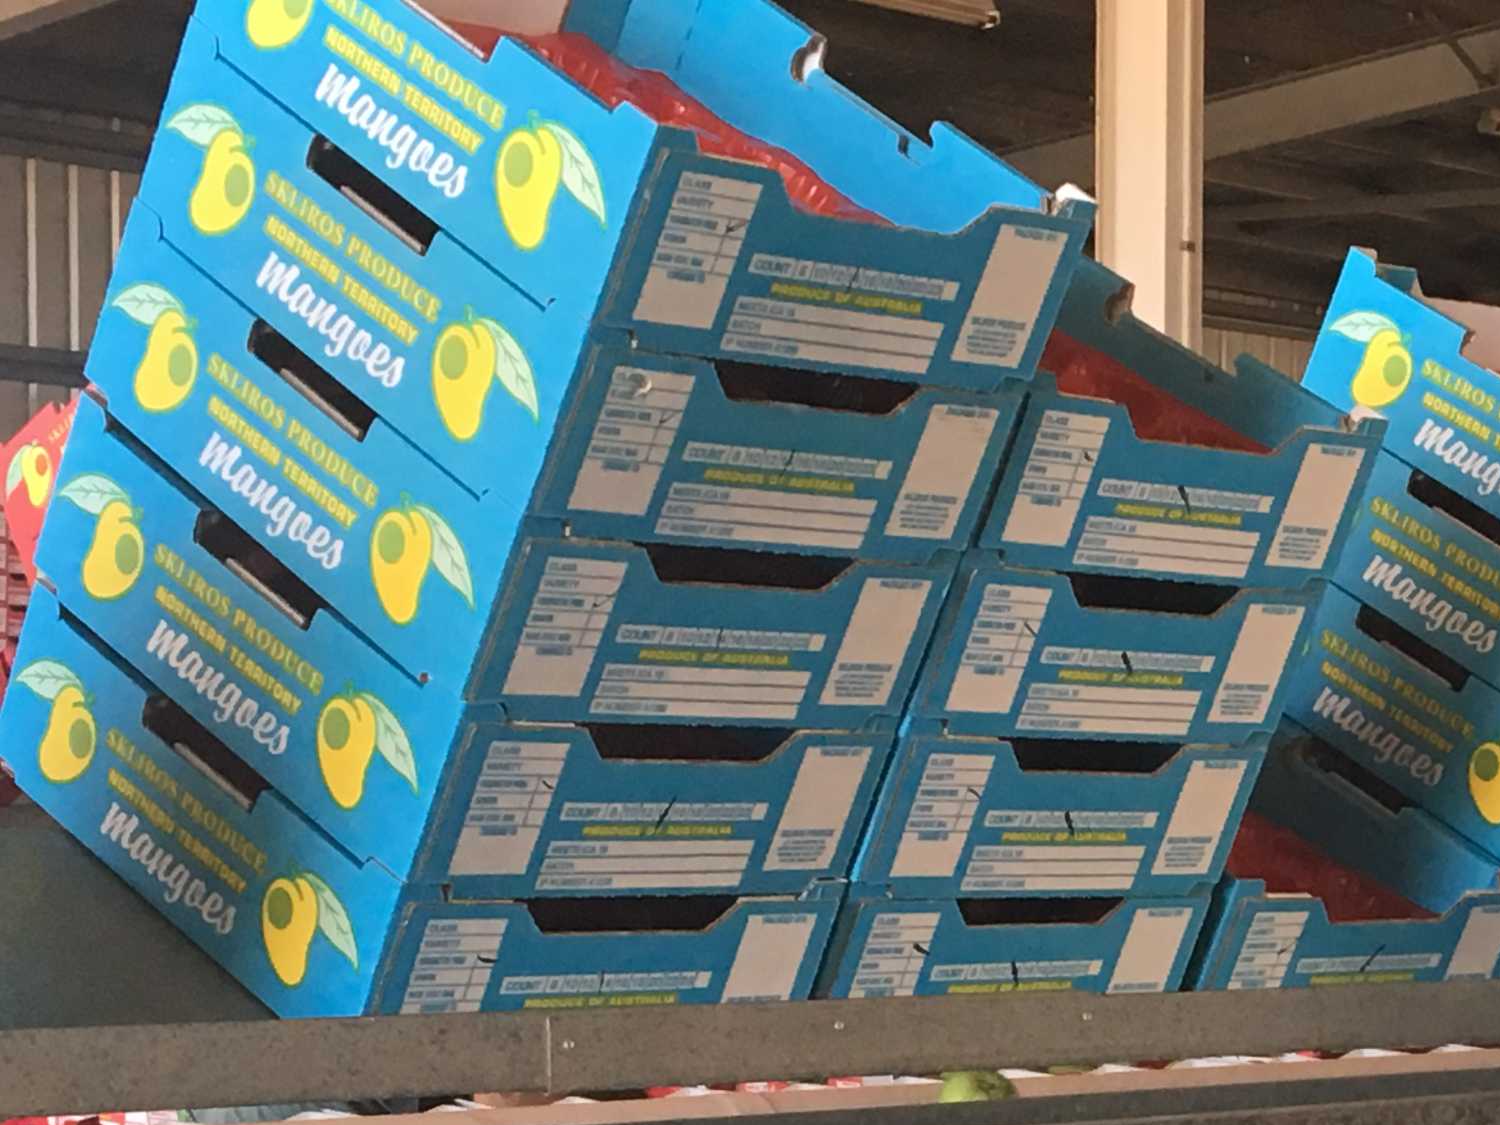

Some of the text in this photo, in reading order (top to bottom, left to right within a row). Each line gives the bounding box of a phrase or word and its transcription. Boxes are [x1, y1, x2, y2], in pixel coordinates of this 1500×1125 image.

[315, 63, 468, 198] Mangoes
[322, 25, 485, 155] NORTHERN TERRITORY
[406, 42, 507, 130] PRODUCE
[263, 214, 420, 348] NORTHERN TERRITORY
[264, 171, 441, 324] SKLIROS PRODUCE
[256, 252, 405, 387] Mangoes
[1422, 358, 1497, 414] SKLIROS
[206, 352, 379, 509] SKLIROS PRODUCE
[207, 394, 358, 530] NORTHERN TERRITORY
[1422, 392, 1493, 444] NORTHERN
[199, 432, 344, 569] Mangoes
[1370, 496, 1441, 550] SKLIROS
[1370, 528, 1439, 577] NORTHERN
[154, 543, 324, 696] SKLIROS PRODUCE
[154, 585, 302, 716] NORTHERN TERRITORY
[1362, 554, 1498, 653] Mangoes
[146, 619, 290, 755] Mangoes
[1312, 686, 1443, 787] Mangoes
[100, 802, 236, 935] Mangoes
